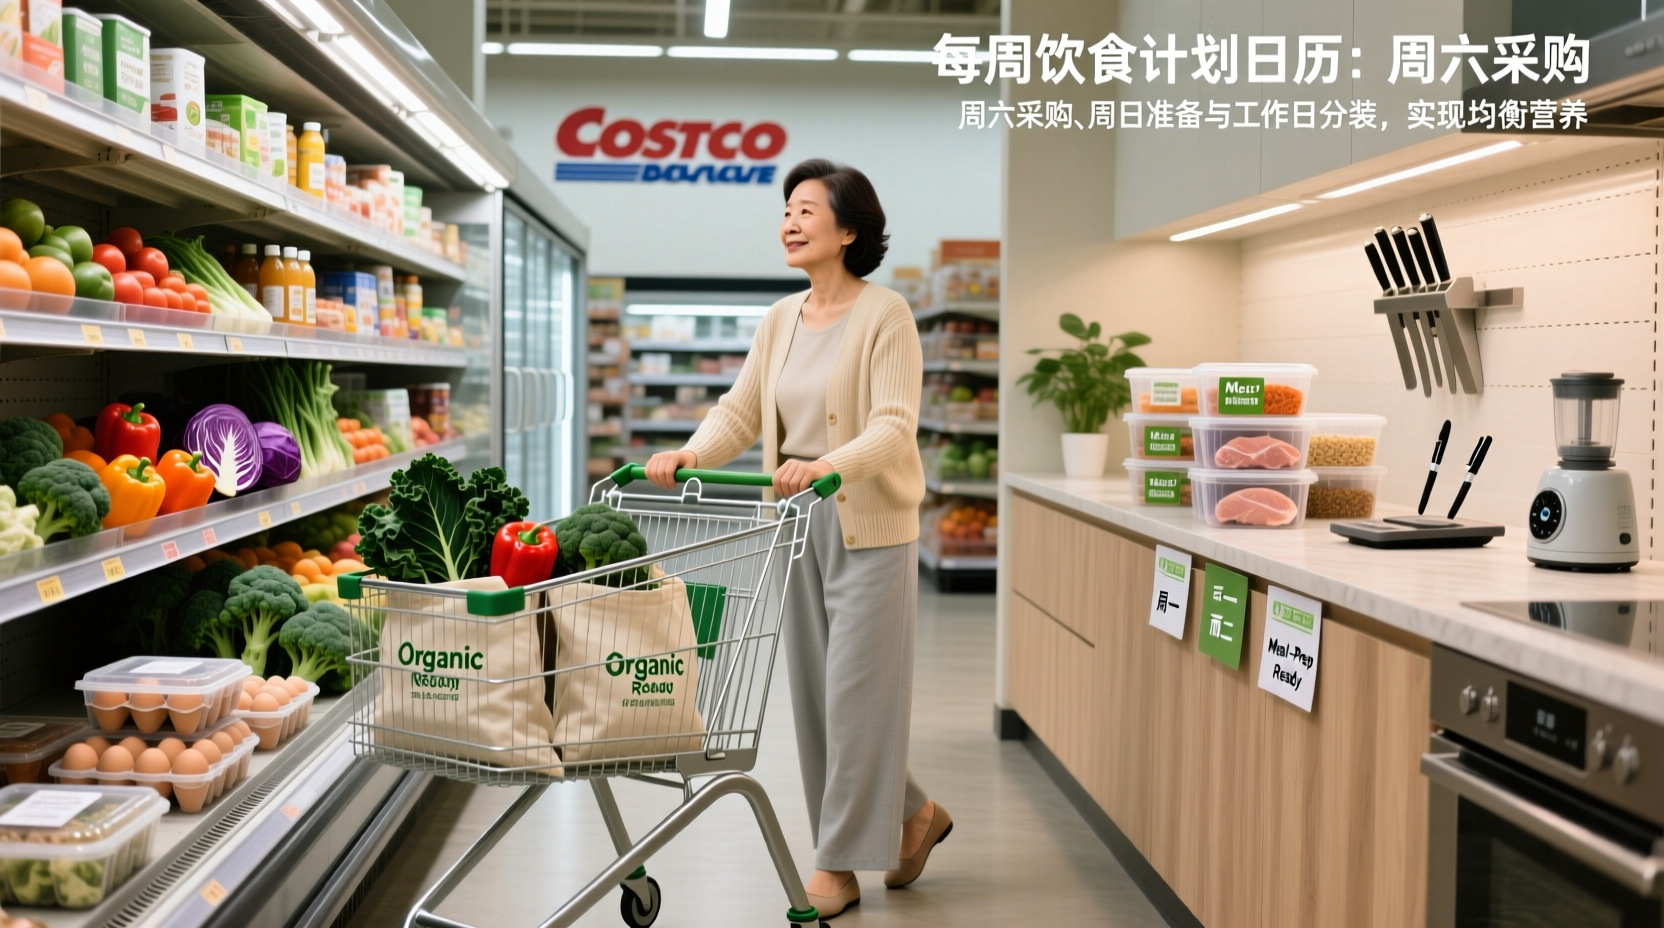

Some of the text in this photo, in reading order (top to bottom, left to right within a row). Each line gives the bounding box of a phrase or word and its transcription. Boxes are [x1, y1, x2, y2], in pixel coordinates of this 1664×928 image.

[398, 641, 484, 673] Organic
[605, 651, 684, 681] Organic
[1268, 637, 1314, 671] Meal-Prep
[1272, 663, 1304, 691] Ready
